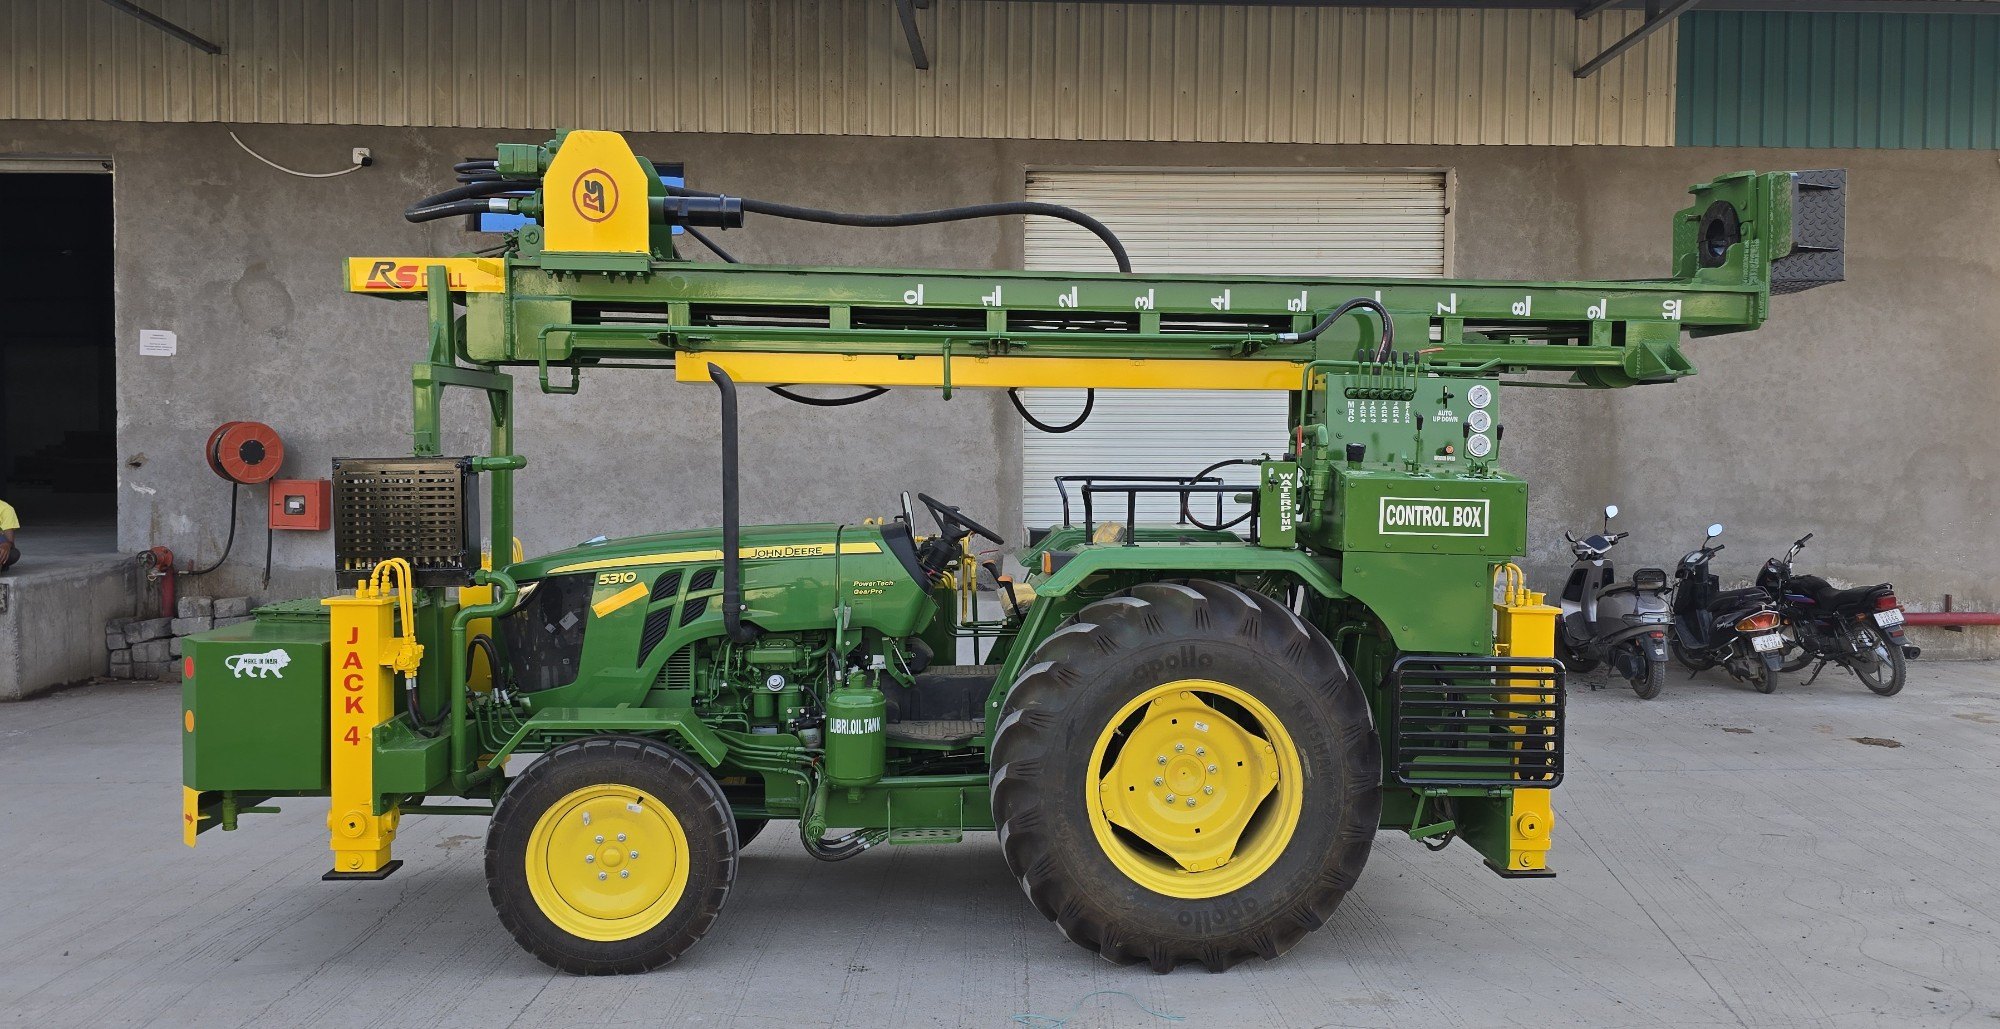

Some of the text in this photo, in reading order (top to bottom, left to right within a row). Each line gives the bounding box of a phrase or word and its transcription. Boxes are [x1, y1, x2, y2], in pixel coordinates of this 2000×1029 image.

[365, 261, 467, 288] RS DLL
[904, 288, 920, 305] 0
[982, 290, 997, 306] 1
[1059, 291, 1074, 307] 2
[1135, 295, 1150, 310] 3
[1211, 294, 1226, 310] 4
[1288, 297, 1303, 312] 5
[1437, 299, 1453, 315] 7
[1512, 300, 1527, 316] 8
[1587, 304, 1602, 319] 9
[1662, 300, 1677, 320] 10
[1347, 401, 1355, 422] MRC
[1279, 473, 1293, 531] WATERPUMP
[1386, 505, 1481, 528] CONTROL BOX
[752, 547, 823, 558] JOHN DEERE
[599, 572, 637, 585] 5310
[342, 627, 364, 746] JACK 4
[864, 717, 881, 733] TANK
